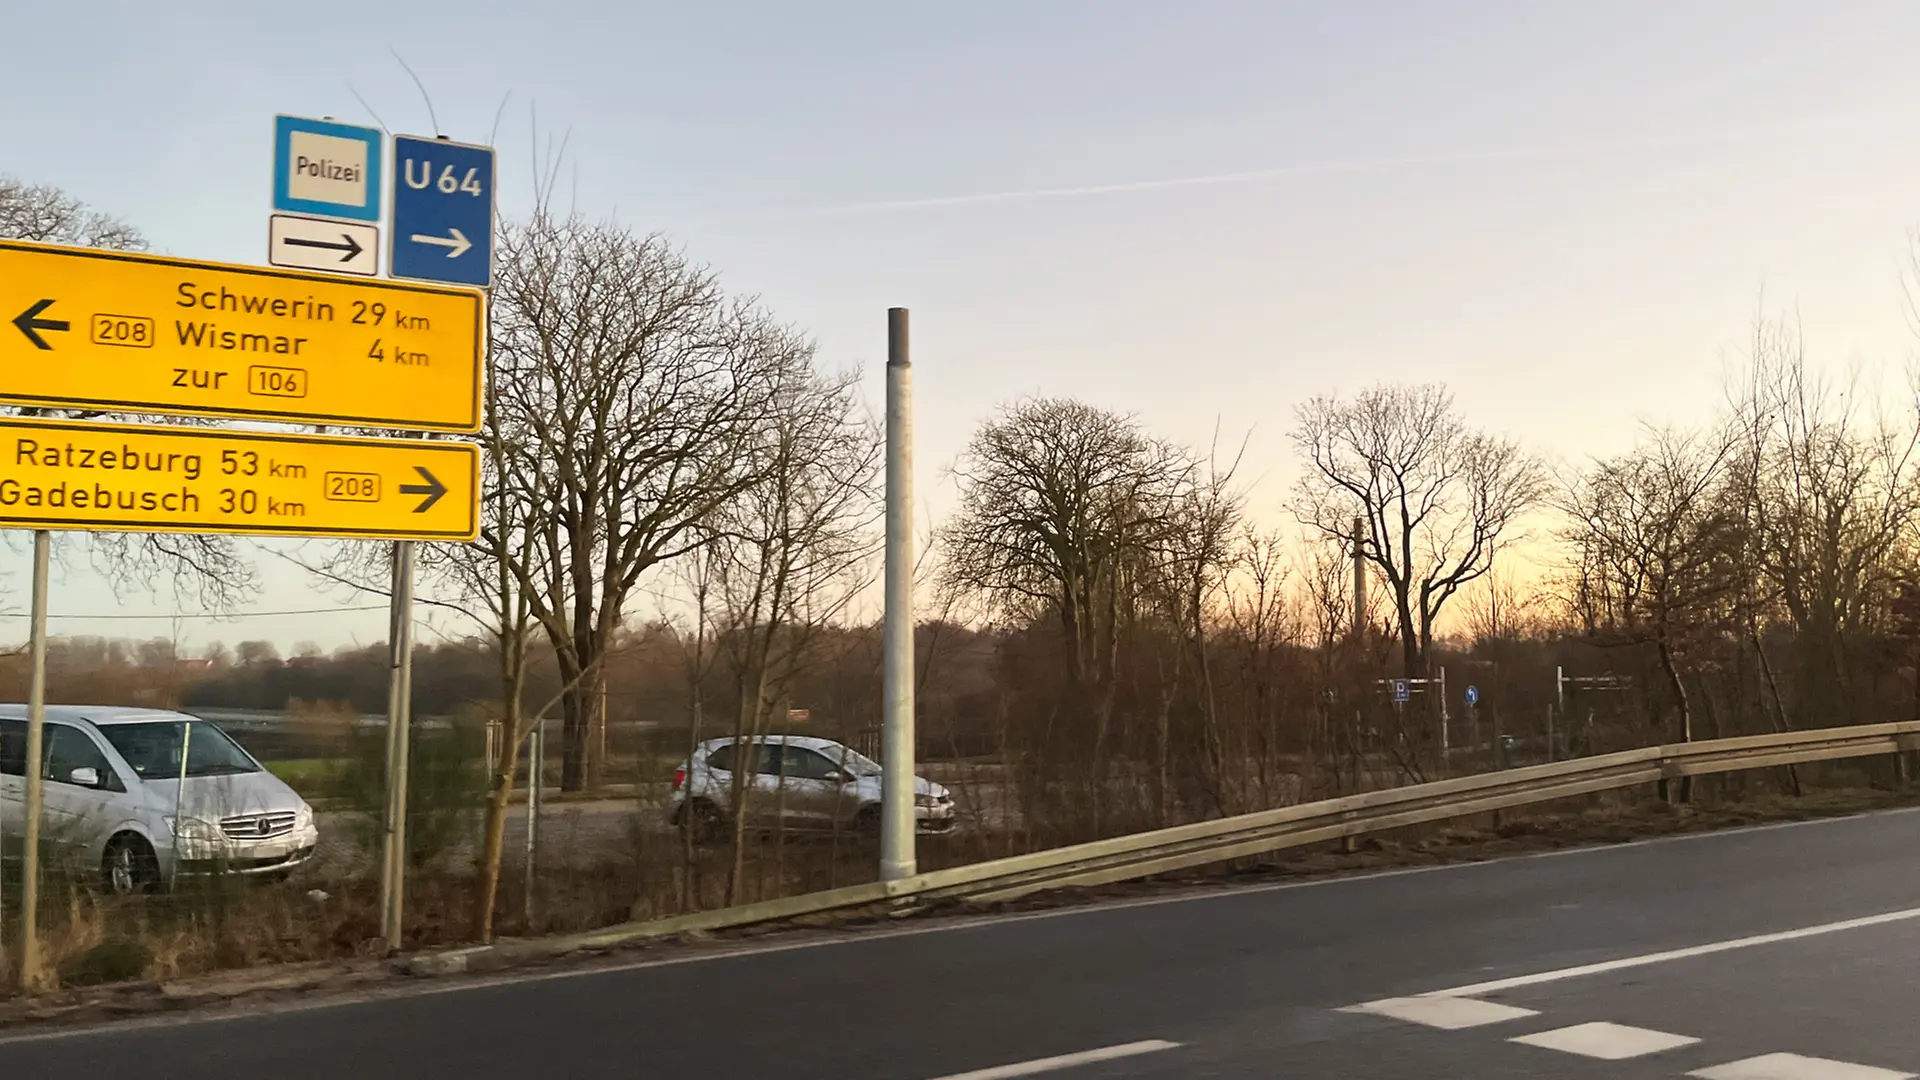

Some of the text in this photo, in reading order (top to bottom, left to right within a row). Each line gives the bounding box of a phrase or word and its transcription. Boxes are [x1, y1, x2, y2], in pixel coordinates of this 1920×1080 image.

[297, 155, 361, 184] Polizei
[405, 158, 482, 197] U 64
[175, 281, 431, 331] Schwerin 29 km
[98, 319, 147, 343] 208
[175, 319, 430, 367] Wismar 4 km
[171, 368, 298, 393] zur 106
[16, 438, 307, 481] Ratzeburg 53 km
[0, 478, 306, 517] Gadebusch 30 km
[331, 477, 374, 497] 208
